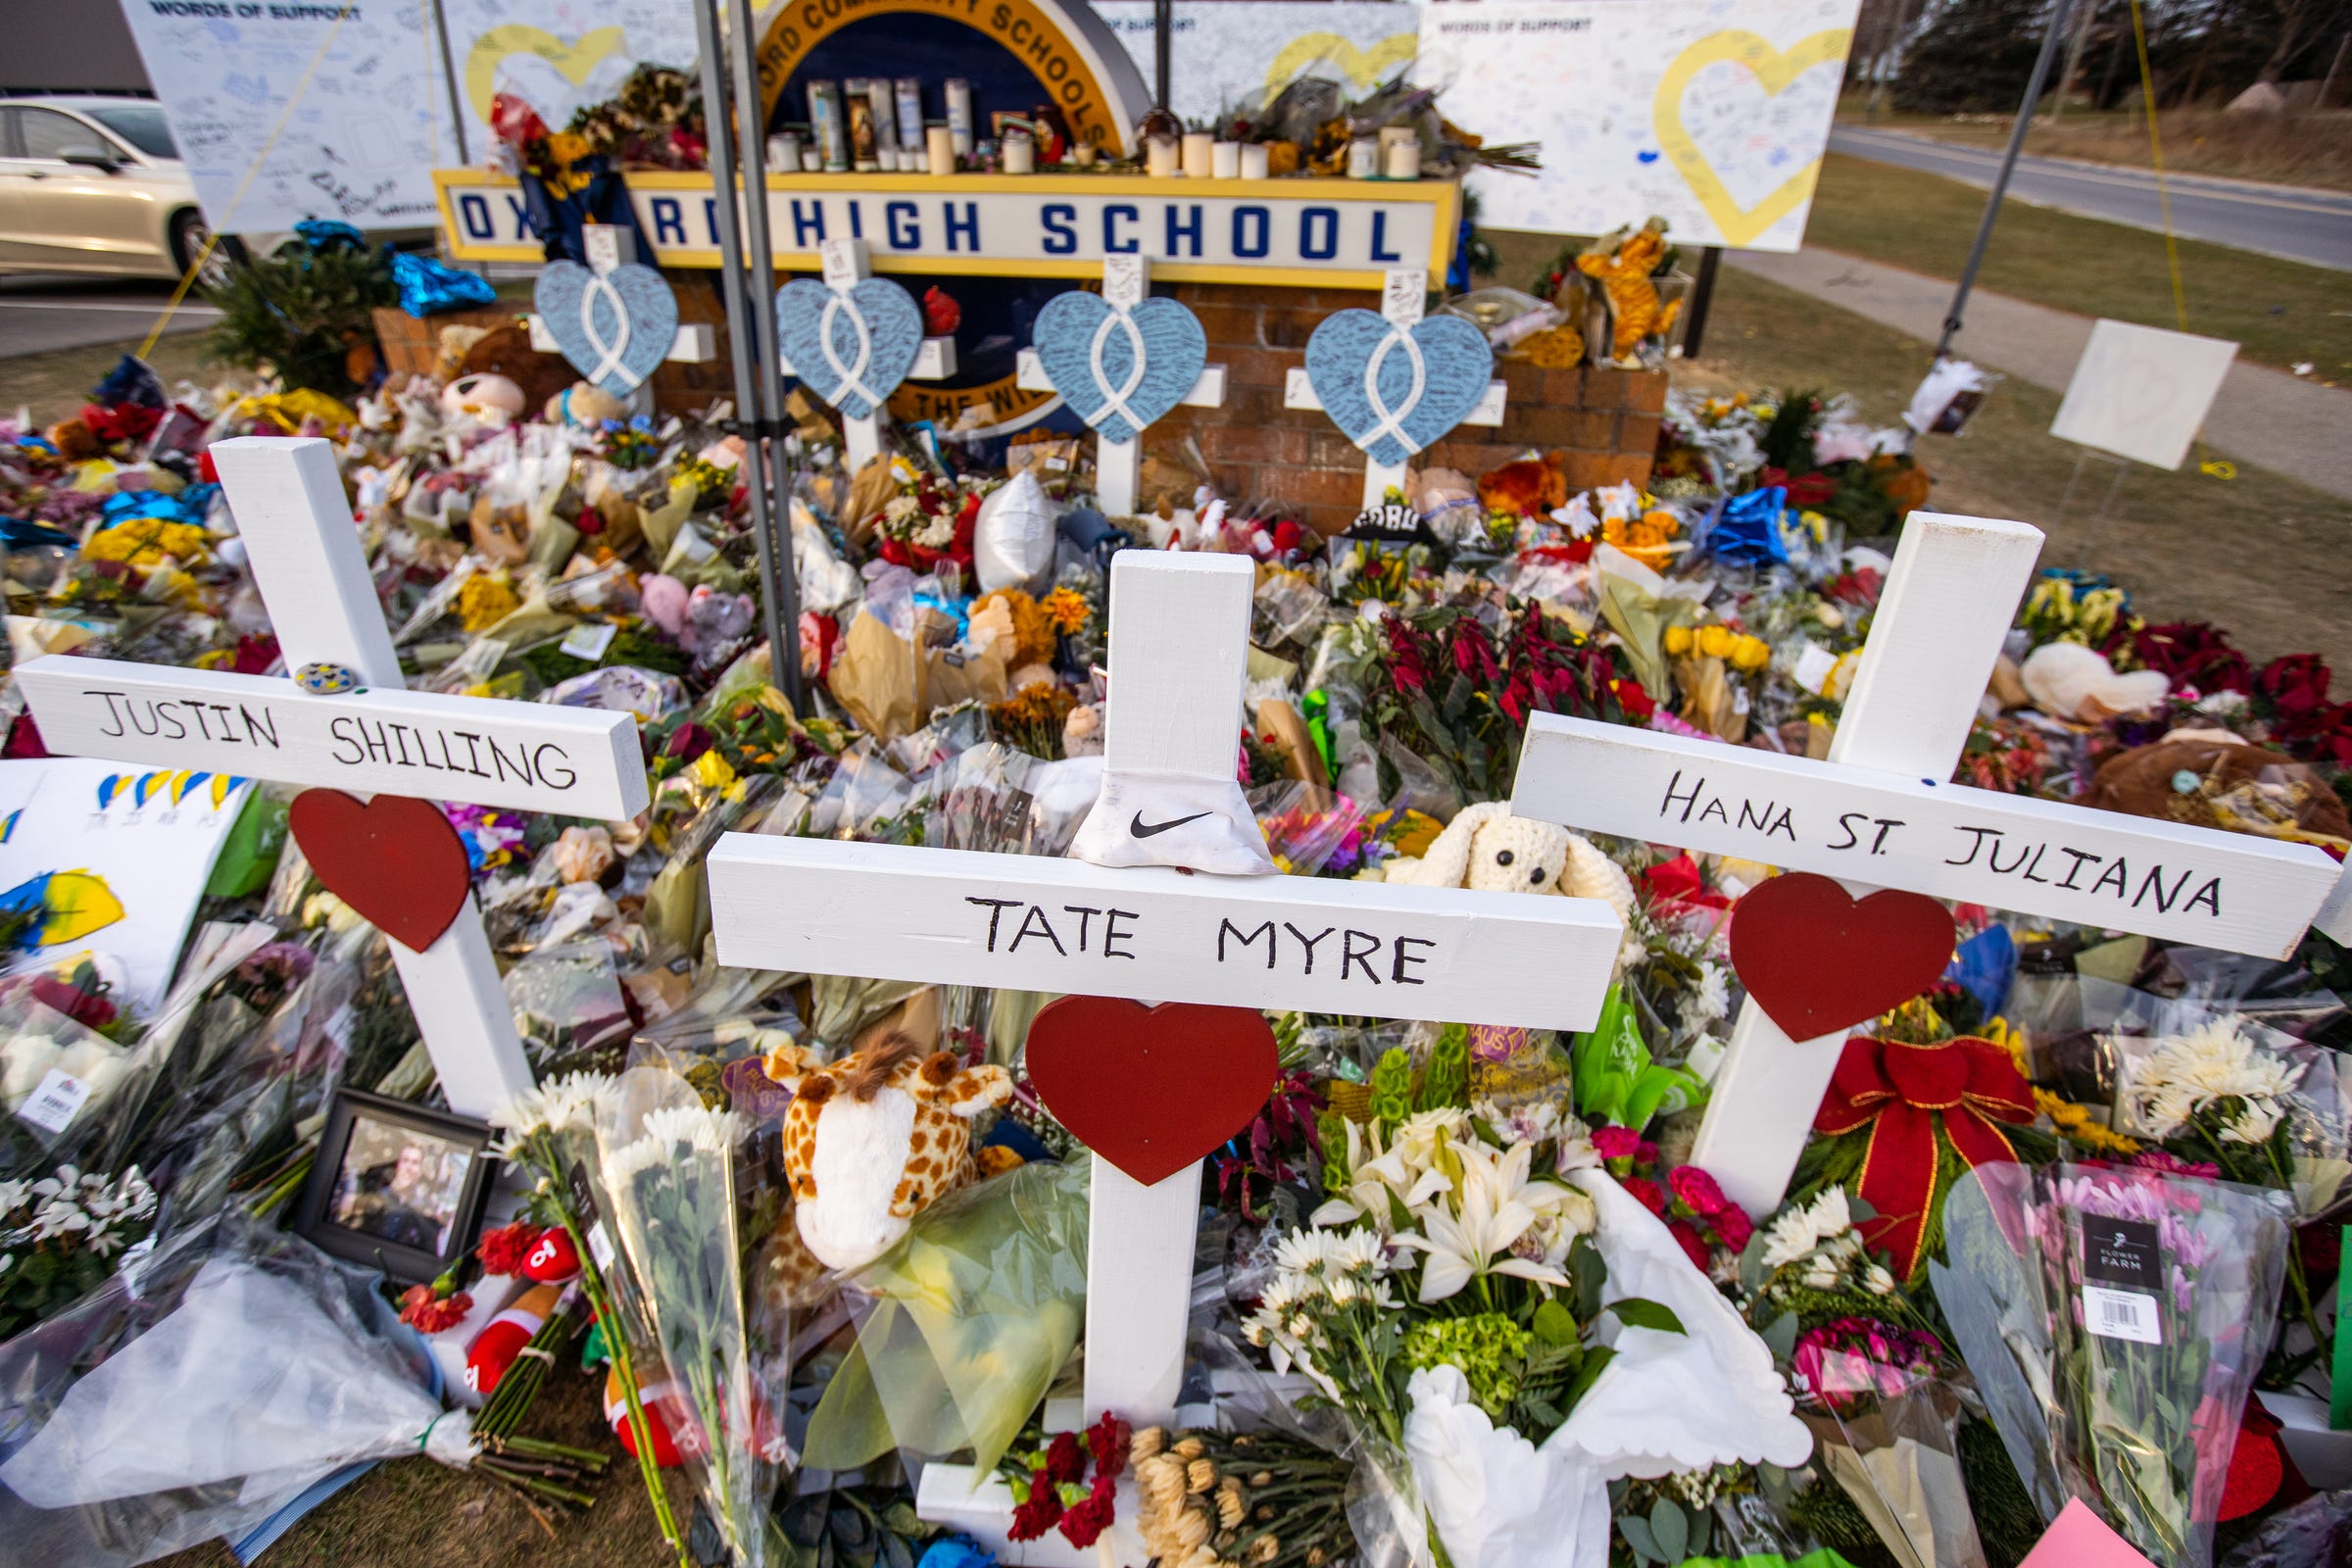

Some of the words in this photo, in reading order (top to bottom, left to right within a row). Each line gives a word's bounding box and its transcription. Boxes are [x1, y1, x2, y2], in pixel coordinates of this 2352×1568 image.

[150, 1, 233, 18] WORDS
[237, 3, 264, 19] OF
[269, 4, 362, 22] SUPPORT
[1441, 22, 1491, 33] WORDS
[1496, 21, 1514, 32] OF
[1521, 18, 1592, 31] SUPPORT
[991, 3, 1106, 150] SCHOOLS
[790, 199, 981, 252] HIGH
[1040, 204, 1401, 263] SCHOOL
[82, 691, 281, 750] JUSTIN
[329, 716, 577, 790] SHILLING
[1659, 769, 1797, 842] HANA
[1826, 812, 1907, 856] ST.
[1944, 826, 2223, 917] JULIANA
[964, 896, 1142, 960] TATE
[1217, 916, 1438, 986] MYRE
[2100, 1248, 2141, 1261] FLOWER
[2100, 1255, 2142, 1271] FARM
